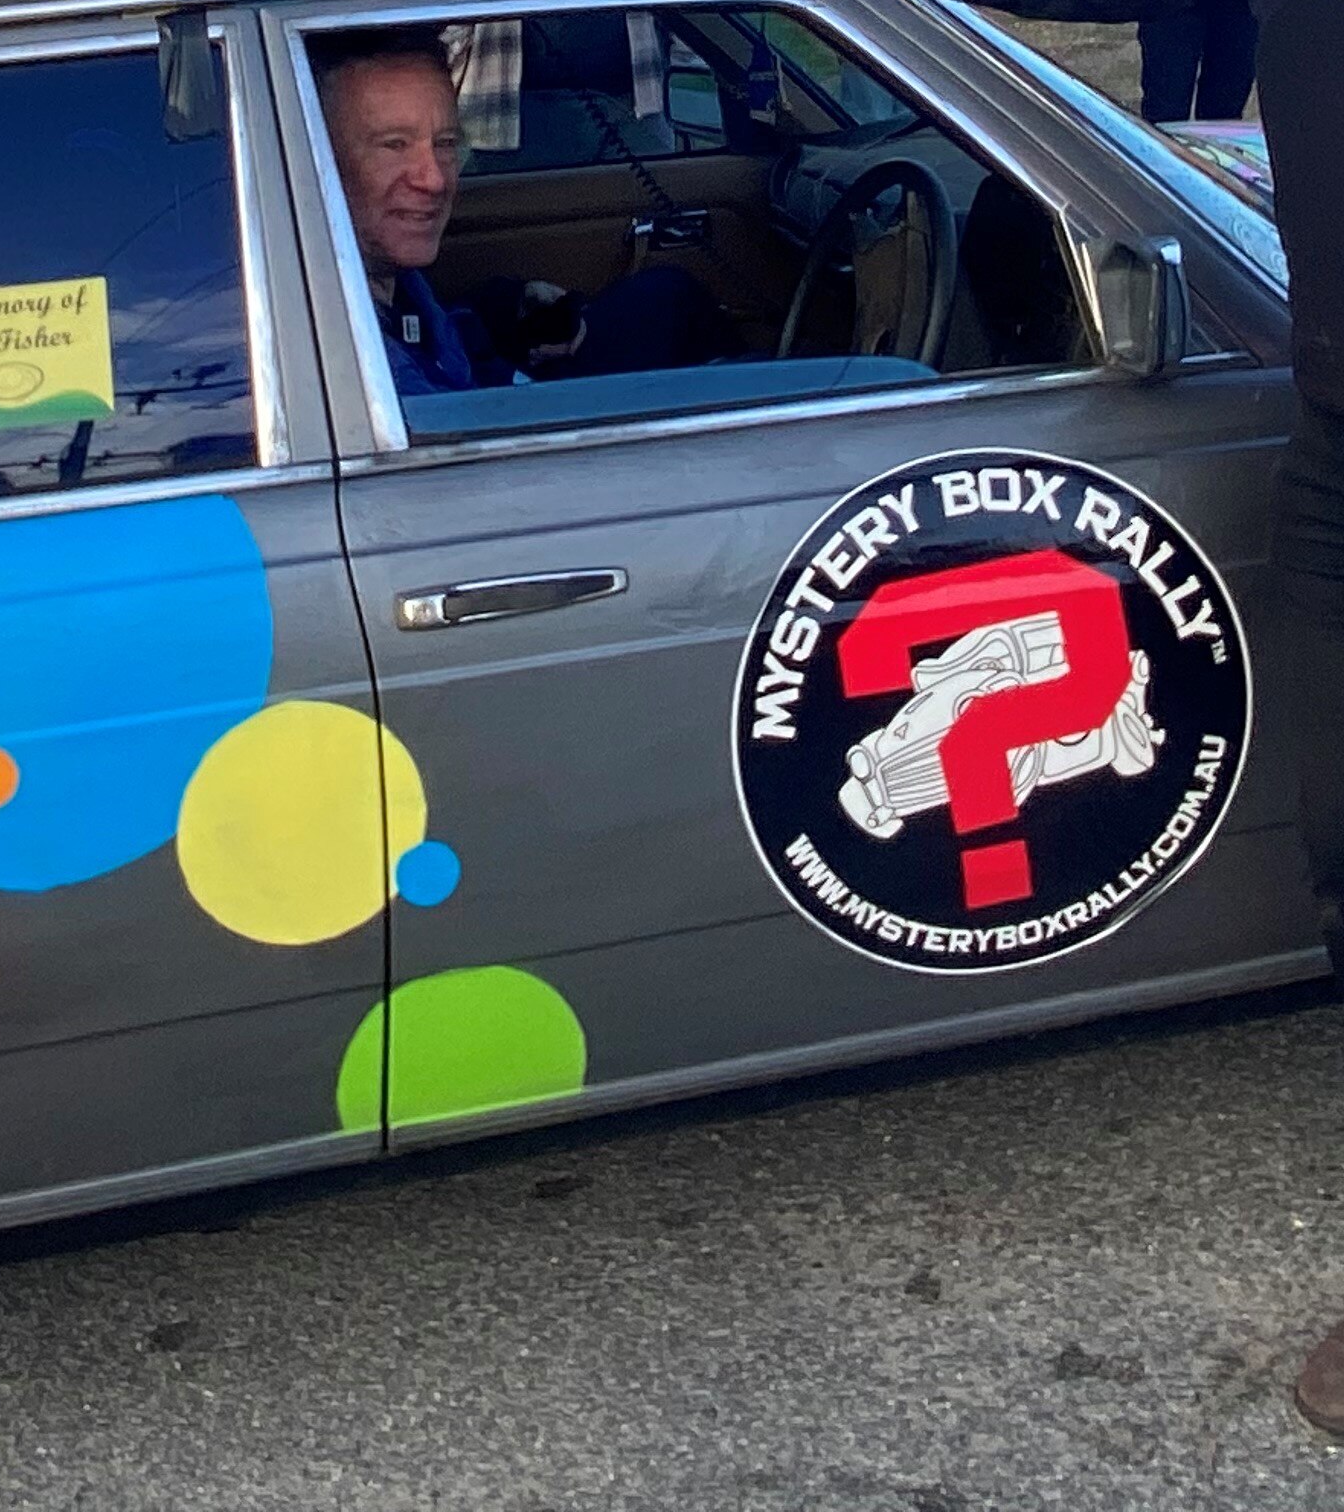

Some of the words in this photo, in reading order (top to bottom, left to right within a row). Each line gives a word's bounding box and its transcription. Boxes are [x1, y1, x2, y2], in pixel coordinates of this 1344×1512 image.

[60, 284, 88, 315] of
[752, 484, 920, 741] MYSTERY
[932, 467, 1067, 521] BOX
[1074, 485, 1222, 640] RALLY
[784, 734, 1227, 955] WWW.MYSTERYBOXRALLY.COM.AU
